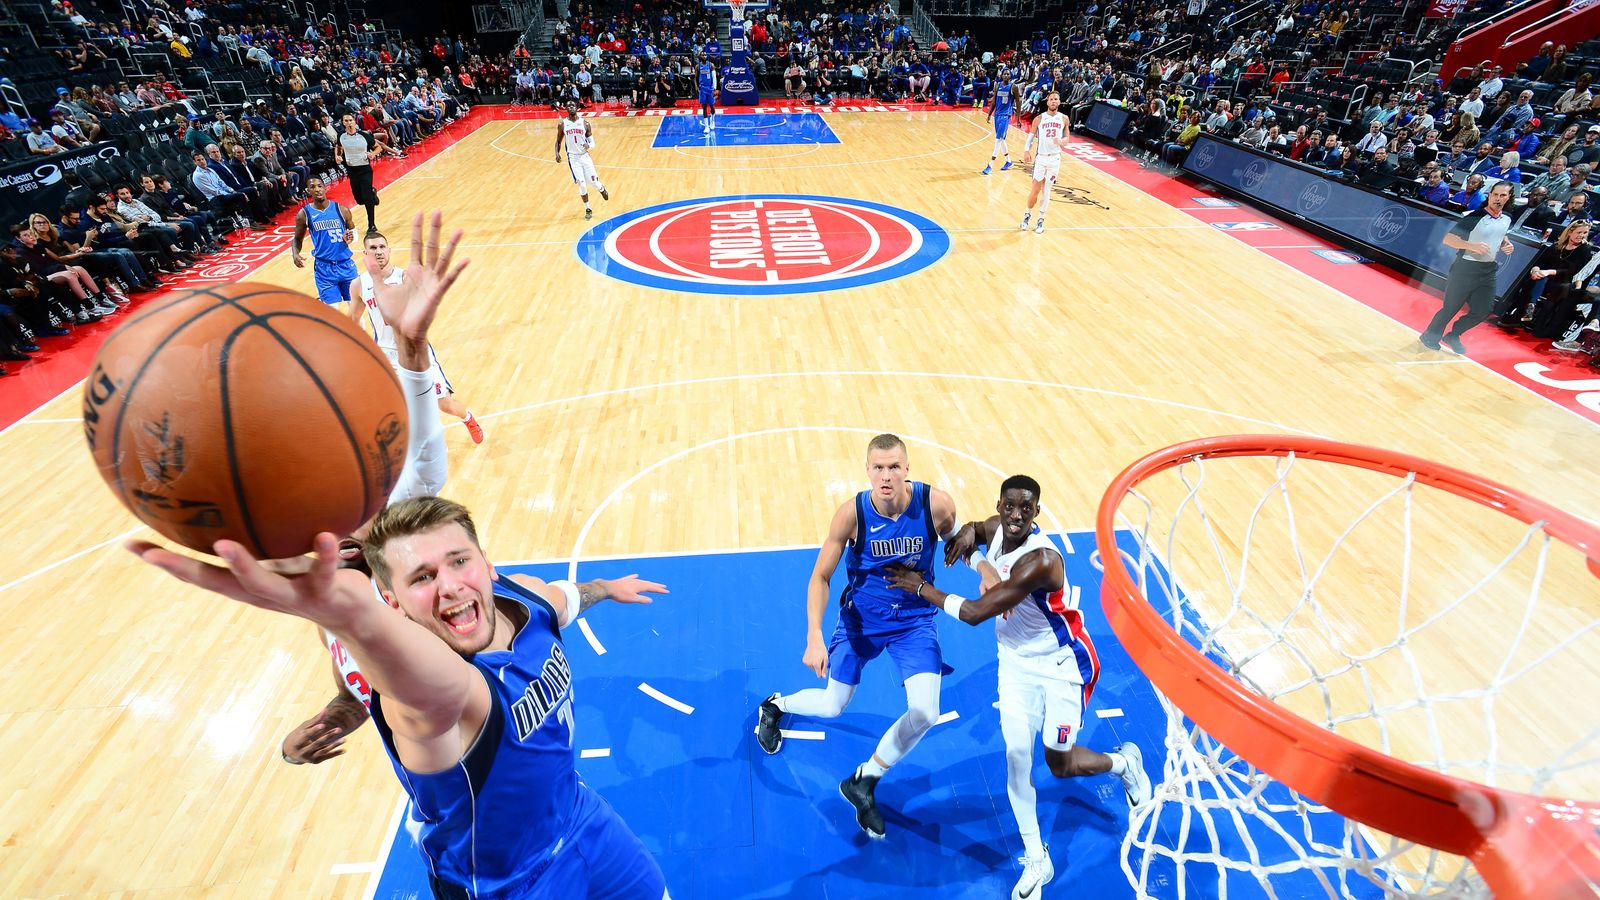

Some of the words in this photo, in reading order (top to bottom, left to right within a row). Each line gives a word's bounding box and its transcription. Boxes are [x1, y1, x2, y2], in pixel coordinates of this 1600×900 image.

[750, 105, 909, 113] PISTONS
[573, 135, 578, 144] 1
[1045, 129, 1057, 138] 23
[7, 172, 34, 184] Caesars
[1243, 168, 1264, 187] Kroger
[18, 182, 39, 194] arena
[1300, 186, 1326, 209] Kroger
[1372, 209, 1403, 239] Kroger
[327, 229, 343, 243] 55
[710, 209, 766, 269] PISTONS
[765, 208, 832, 265] DETROIT
[171, 225, 297, 290] DETROI
[870, 536, 923, 557] DALLAS
[511, 642, 571, 742] DALLAS
